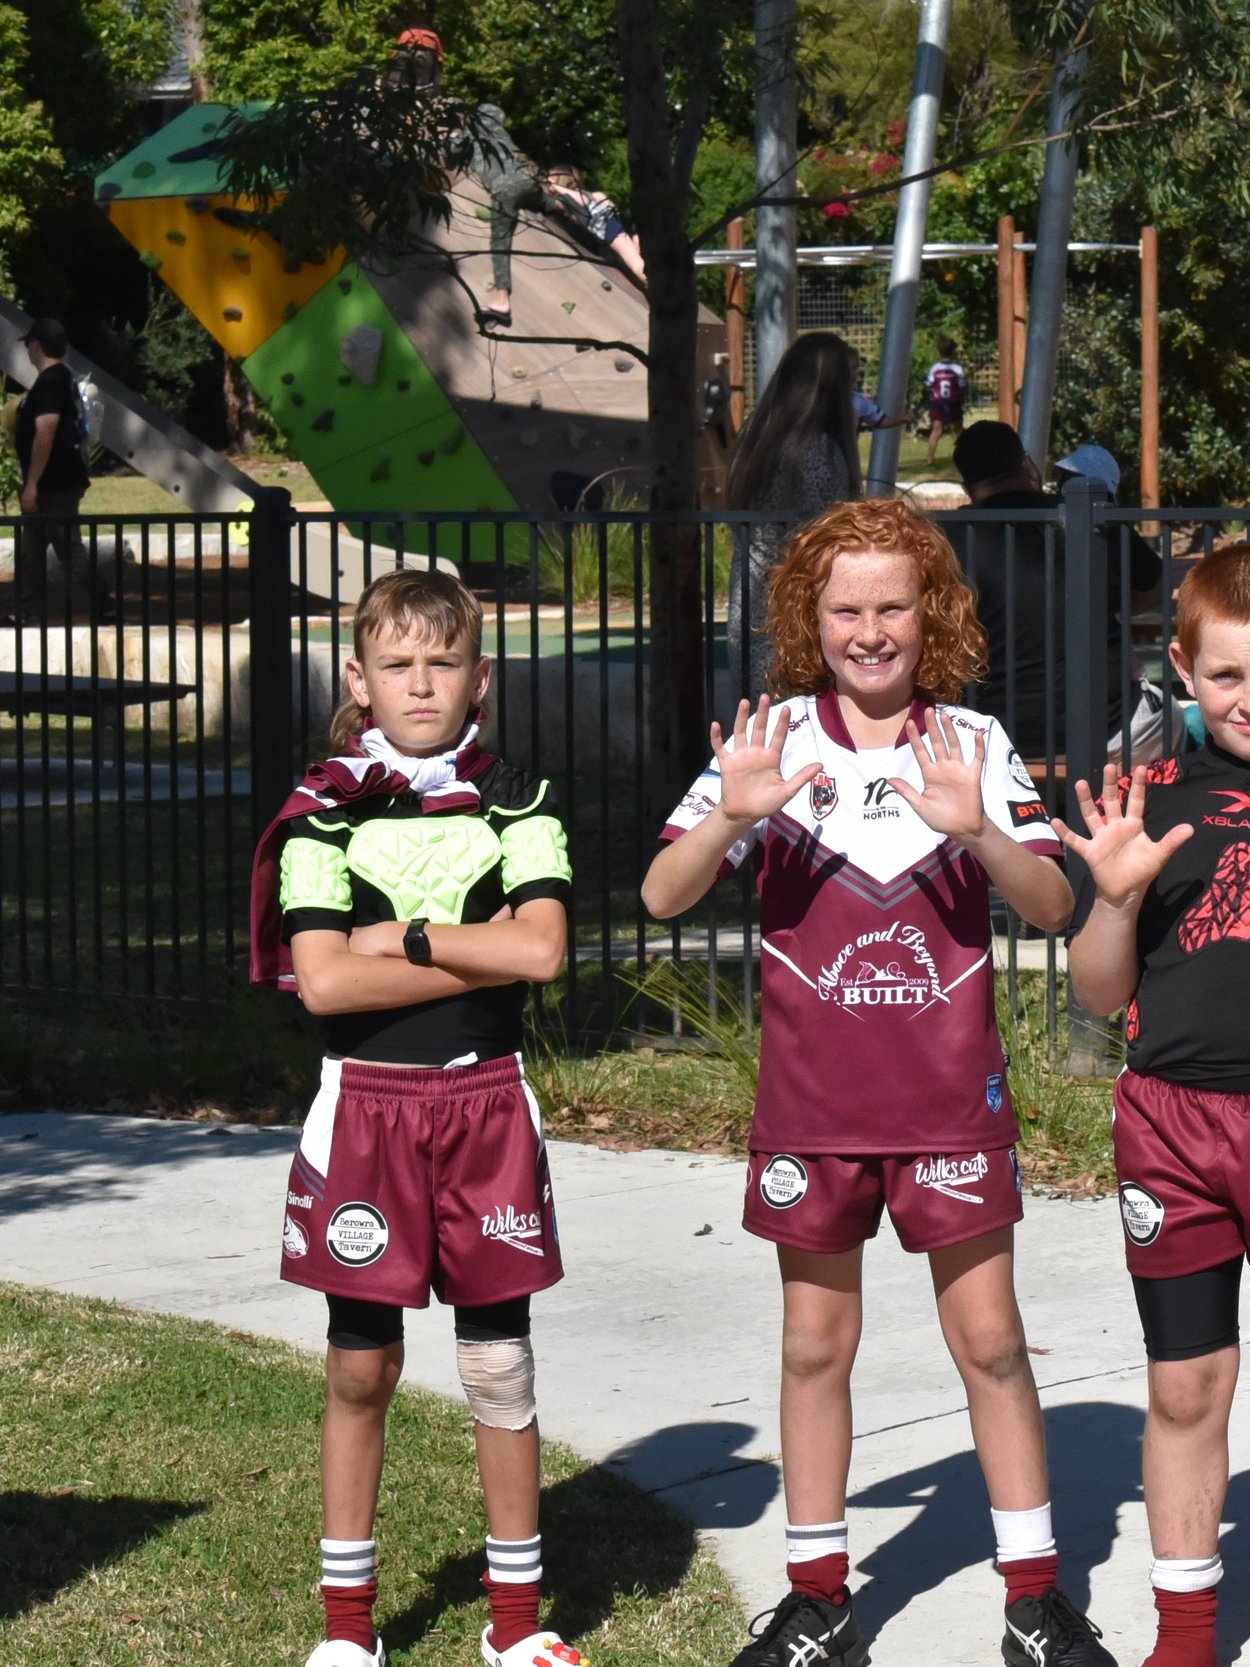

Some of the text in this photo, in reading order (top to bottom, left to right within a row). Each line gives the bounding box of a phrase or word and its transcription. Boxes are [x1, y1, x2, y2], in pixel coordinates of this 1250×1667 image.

[863, 810, 900, 820] NORTHS
[818, 920, 951, 1005] Above and Beyond
[840, 978, 929, 987] Est 2009
[842, 987, 928, 1005] BUILT
[915, 1152, 988, 1184] Wilks cuts
[340, 1217, 374, 1228] Berowra
[481, 1204, 527, 1236] Wilks
[338, 1230, 374, 1241] VILLAGE
[338, 1242, 372, 1252] Tavern
